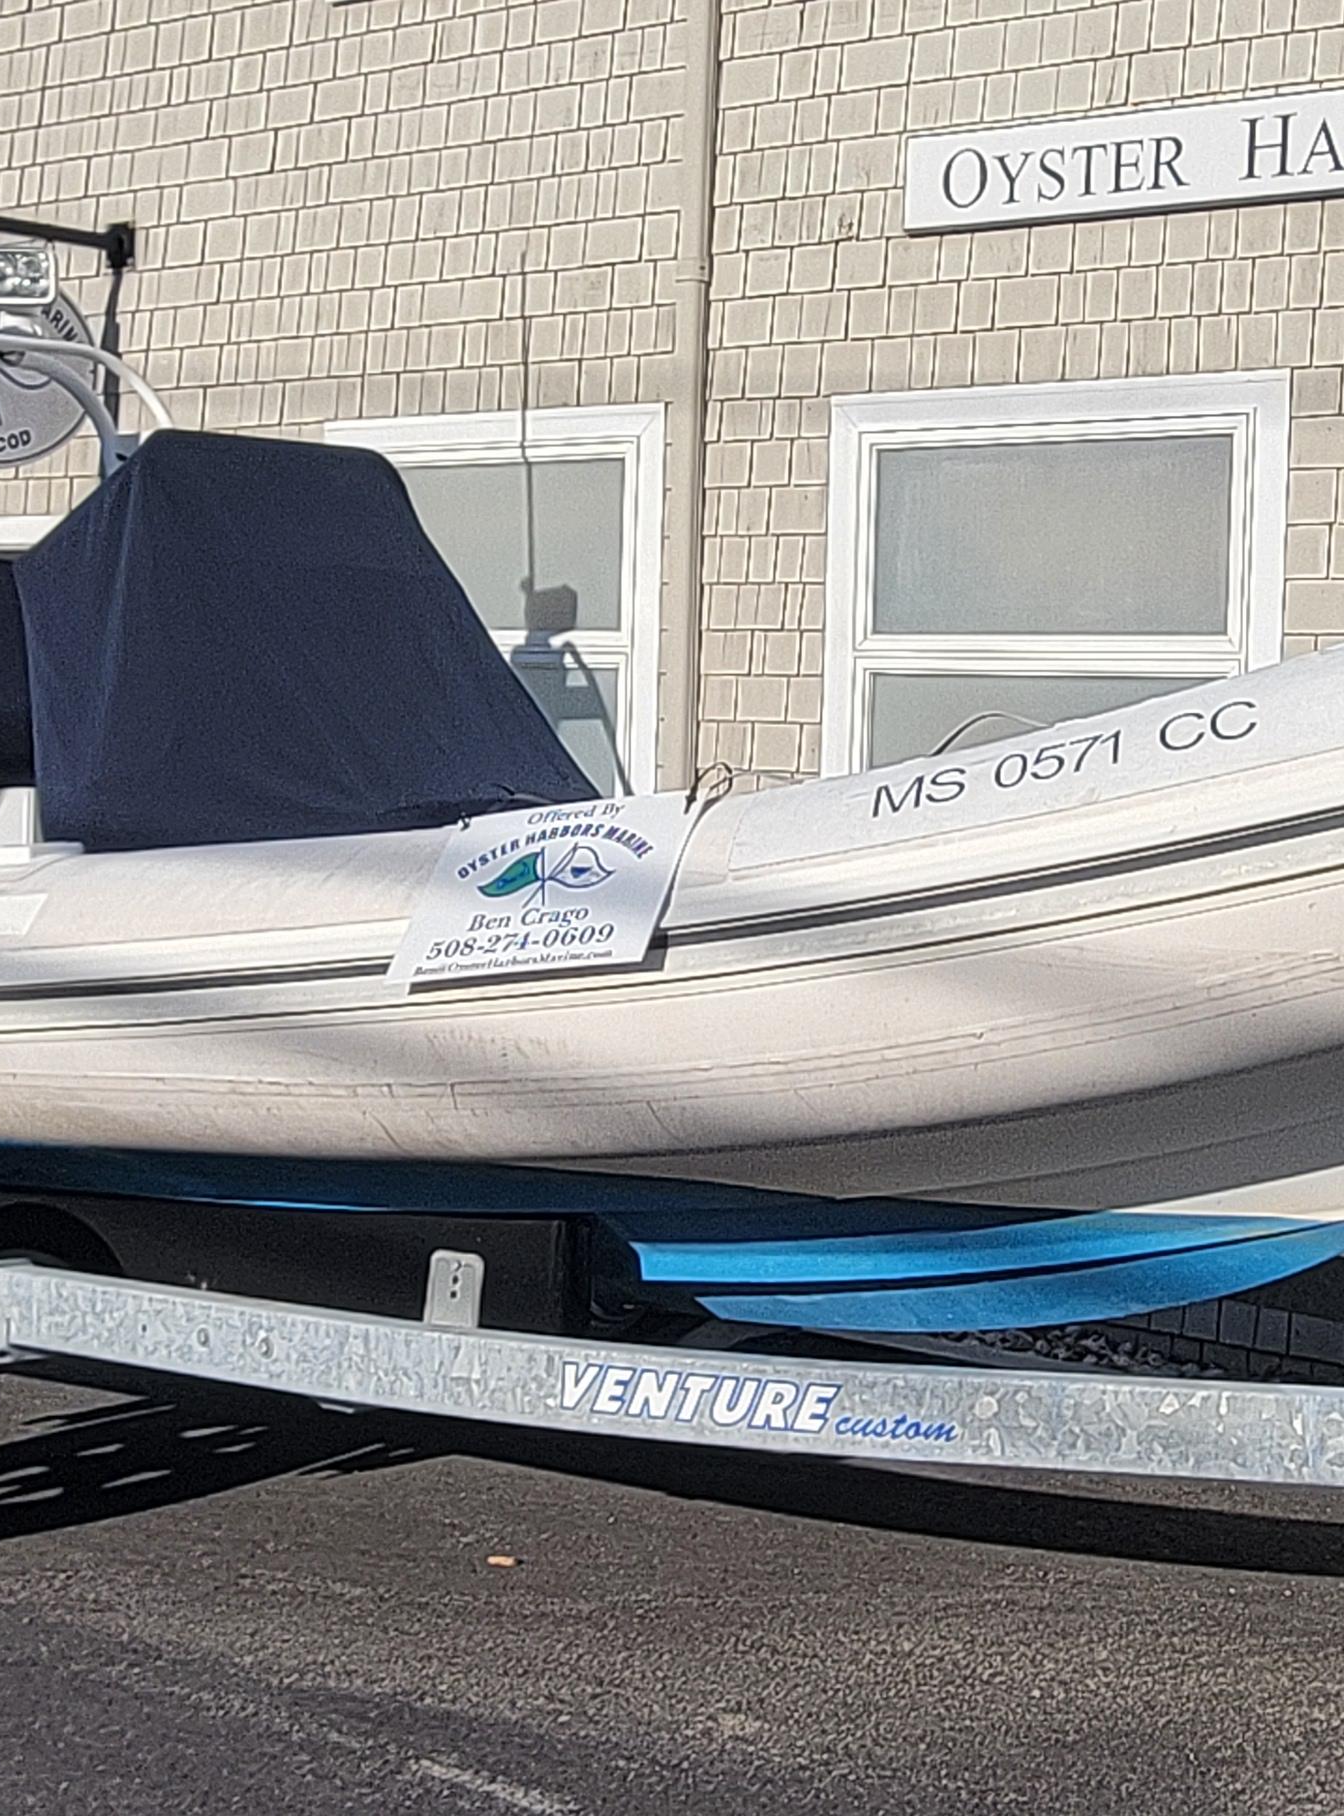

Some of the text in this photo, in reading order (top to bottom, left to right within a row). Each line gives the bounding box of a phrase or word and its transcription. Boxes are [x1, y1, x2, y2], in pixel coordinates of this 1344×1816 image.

[941, 136, 1189, 211] OYSTER
[871, 700, 1258, 818] MS 0571 CC
[527, 802, 626, 825] Offered By
[457, 823, 654, 879] OYSTER HARBORS MARINE
[426, 923, 615, 961] 508-274-0609
[467, 907, 589, 932] Ben Crago
[558, 1360, 958, 1443] VENTURE custom
